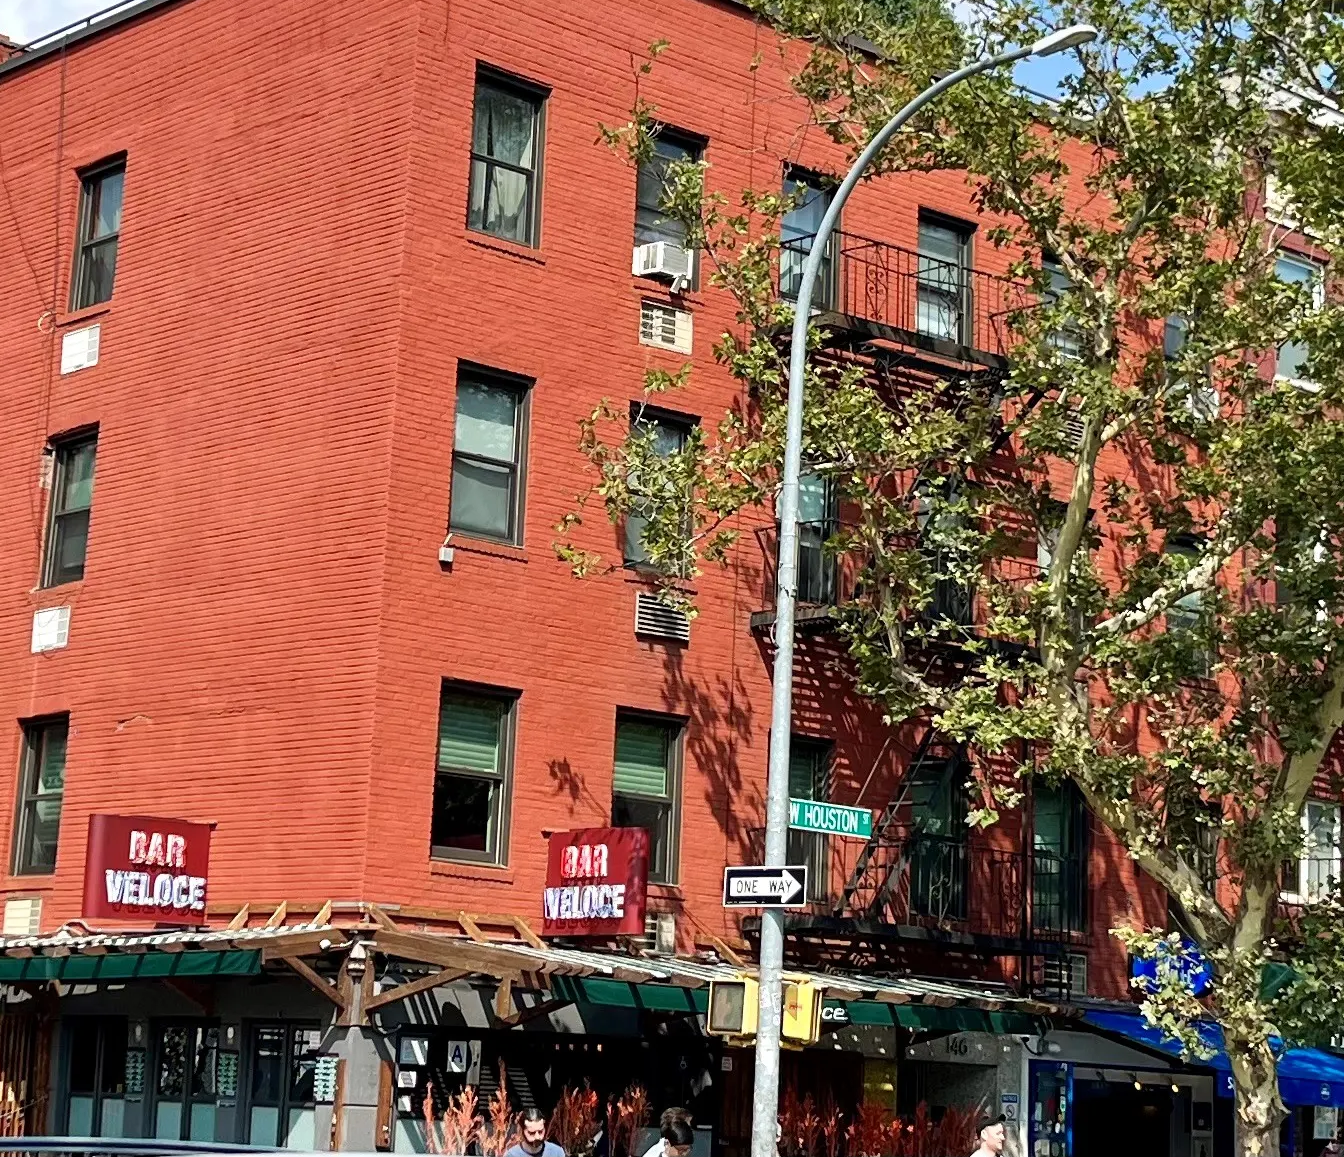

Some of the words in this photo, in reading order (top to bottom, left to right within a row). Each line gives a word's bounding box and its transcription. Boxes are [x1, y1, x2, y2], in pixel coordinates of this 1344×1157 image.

[789, 803, 800, 823] W
[804, 805, 858, 832] HOUSTON
[862, 813, 870, 825] ST
[129, 830, 186, 868] BAR
[560, 843, 608, 879] BAR
[105, 869, 207, 910] VELOCE
[543, 884, 626, 920] VELOCE
[736, 879, 759, 894] ONE
[769, 879, 793, 894] WAY
[451, 1044, 463, 1063] A
[945, 1036, 968, 1057] 146
